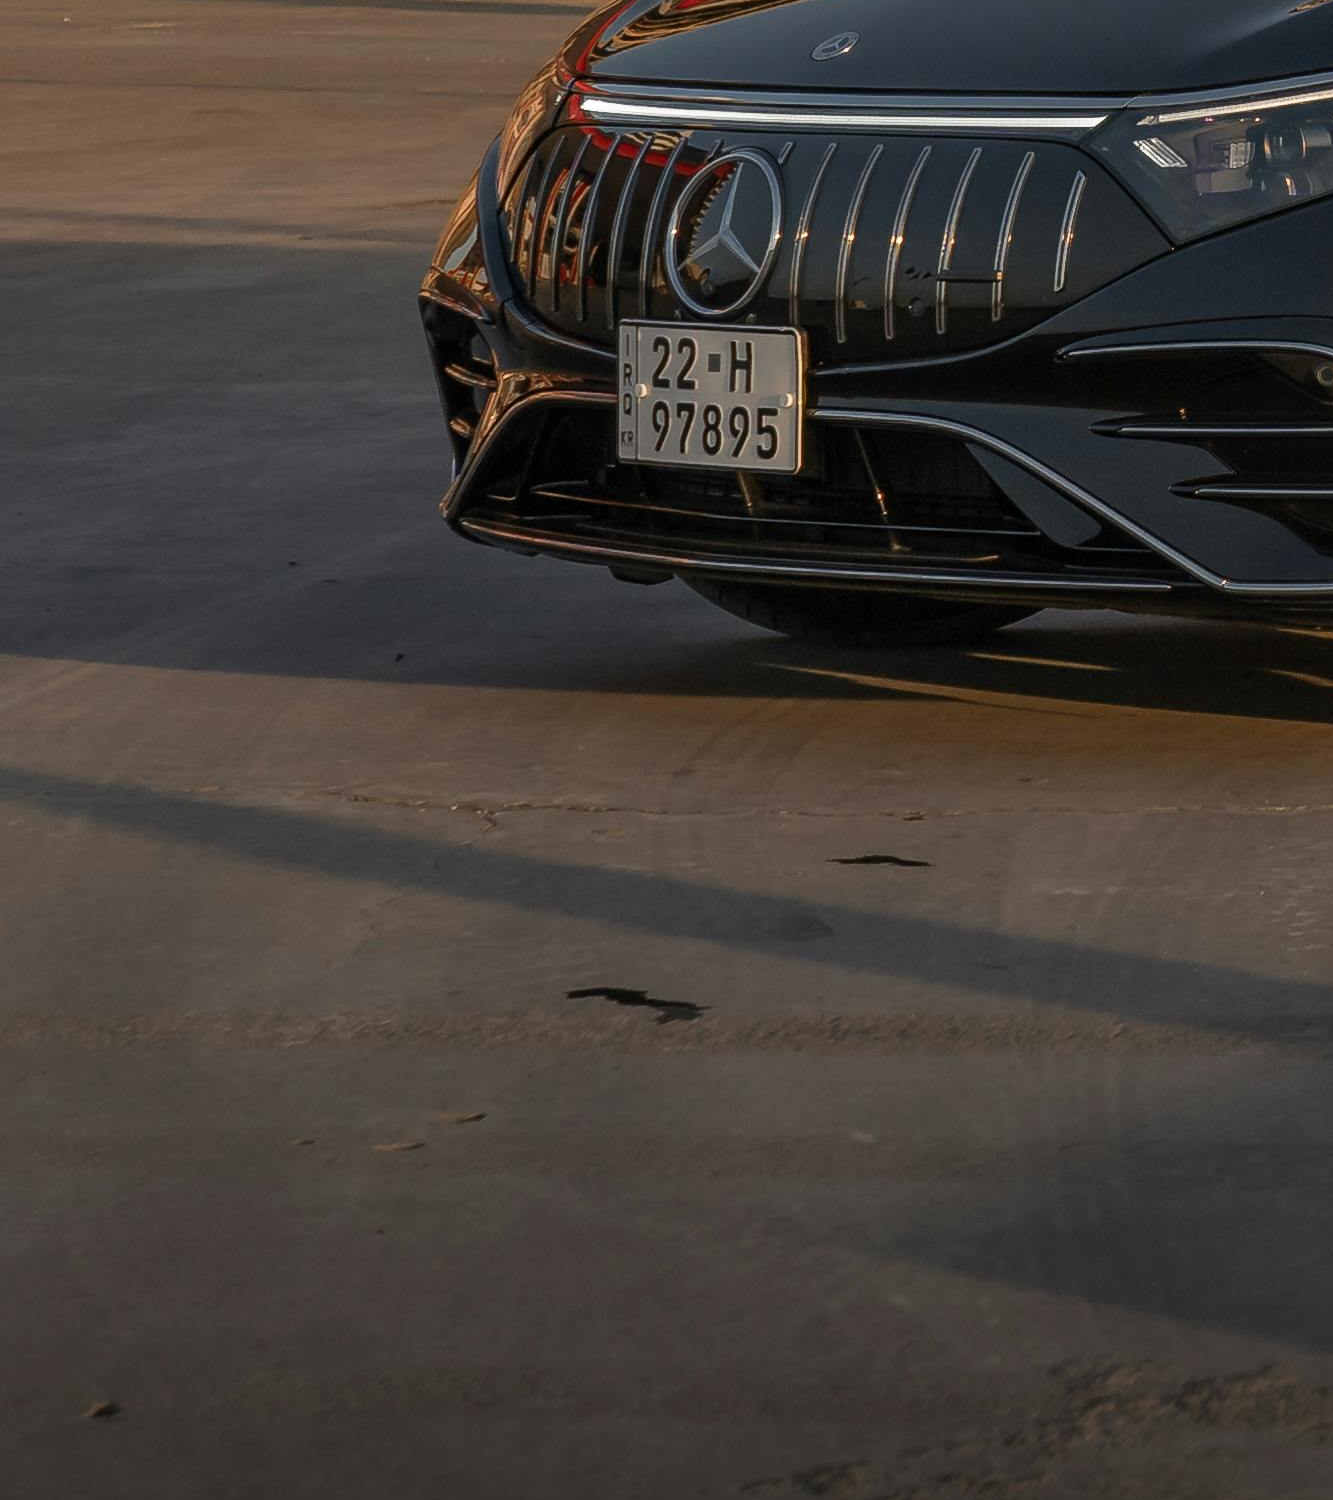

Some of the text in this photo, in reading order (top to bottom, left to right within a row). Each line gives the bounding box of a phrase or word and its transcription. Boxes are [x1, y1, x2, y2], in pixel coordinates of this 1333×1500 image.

[651, 335, 753, 394] 22 H
[651, 400, 780, 460] 97895
